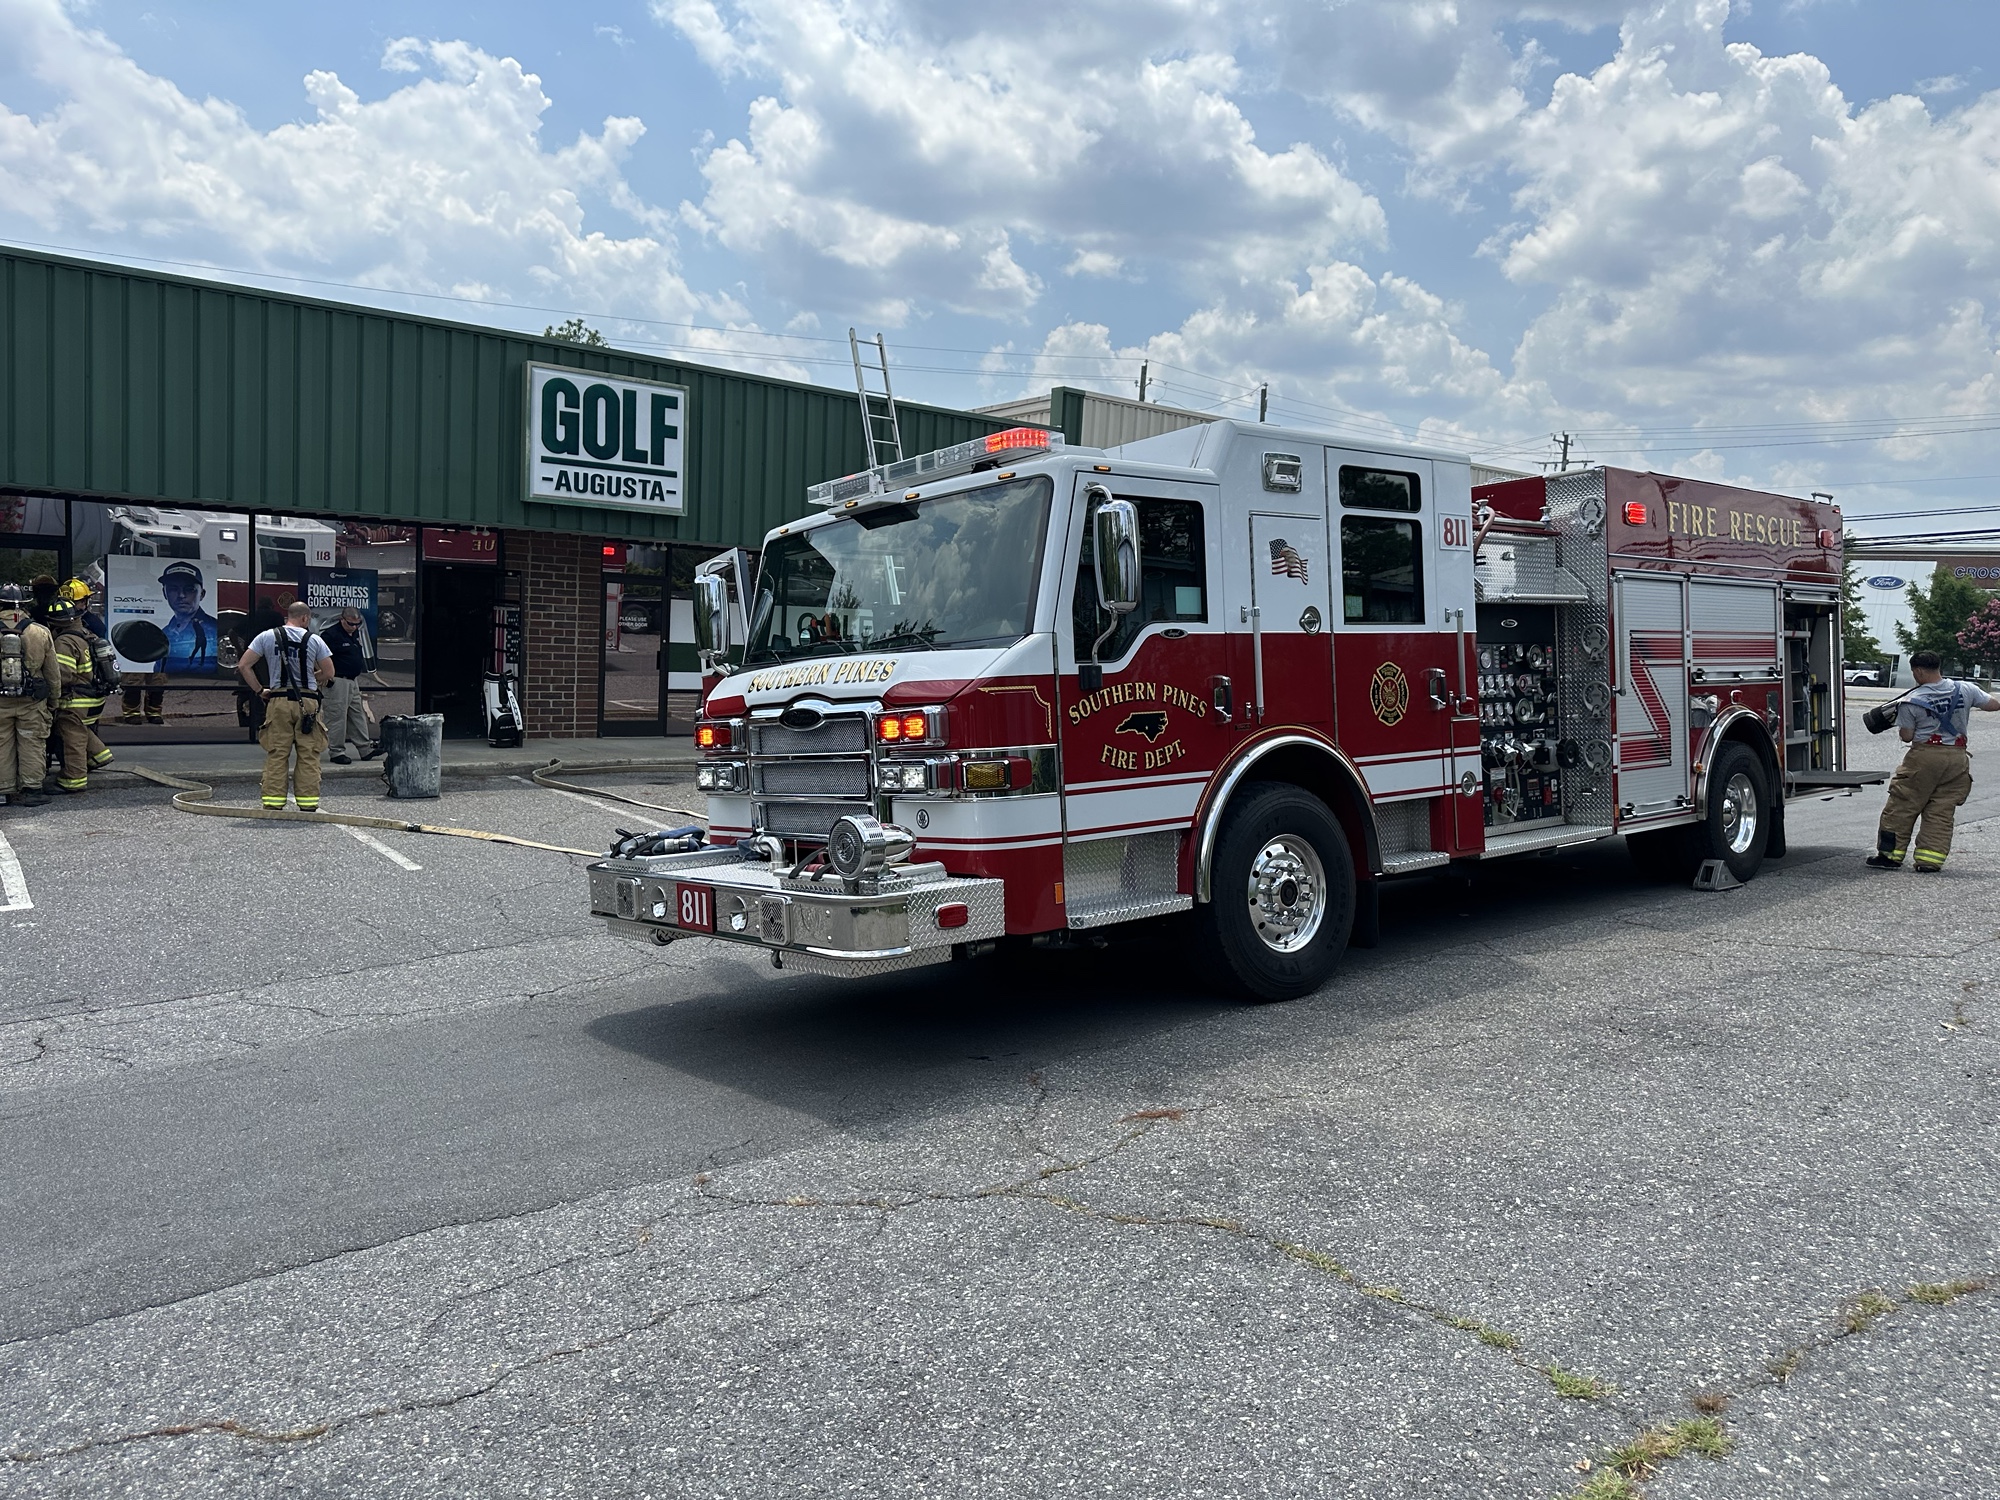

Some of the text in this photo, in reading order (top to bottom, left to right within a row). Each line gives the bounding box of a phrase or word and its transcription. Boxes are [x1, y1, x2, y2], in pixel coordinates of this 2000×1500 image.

[541, 377, 678, 466] GOLF
[1443, 517, 1468, 547] 811
[1667, 501, 1803, 548] FIRE RESCUE
[307, 584, 369, 598] FORGIVENESS
[1873, 577, 1896, 587] Ford
[307, 596, 369, 610] GOES PREMIUM
[748, 659, 899, 693] SOUTHERN PINES
[1069, 682, 1208, 725] SOUTHERN PINES
[1100, 739, 1186, 770] FIRE DEPT.
[681, 889, 709, 926] 811
